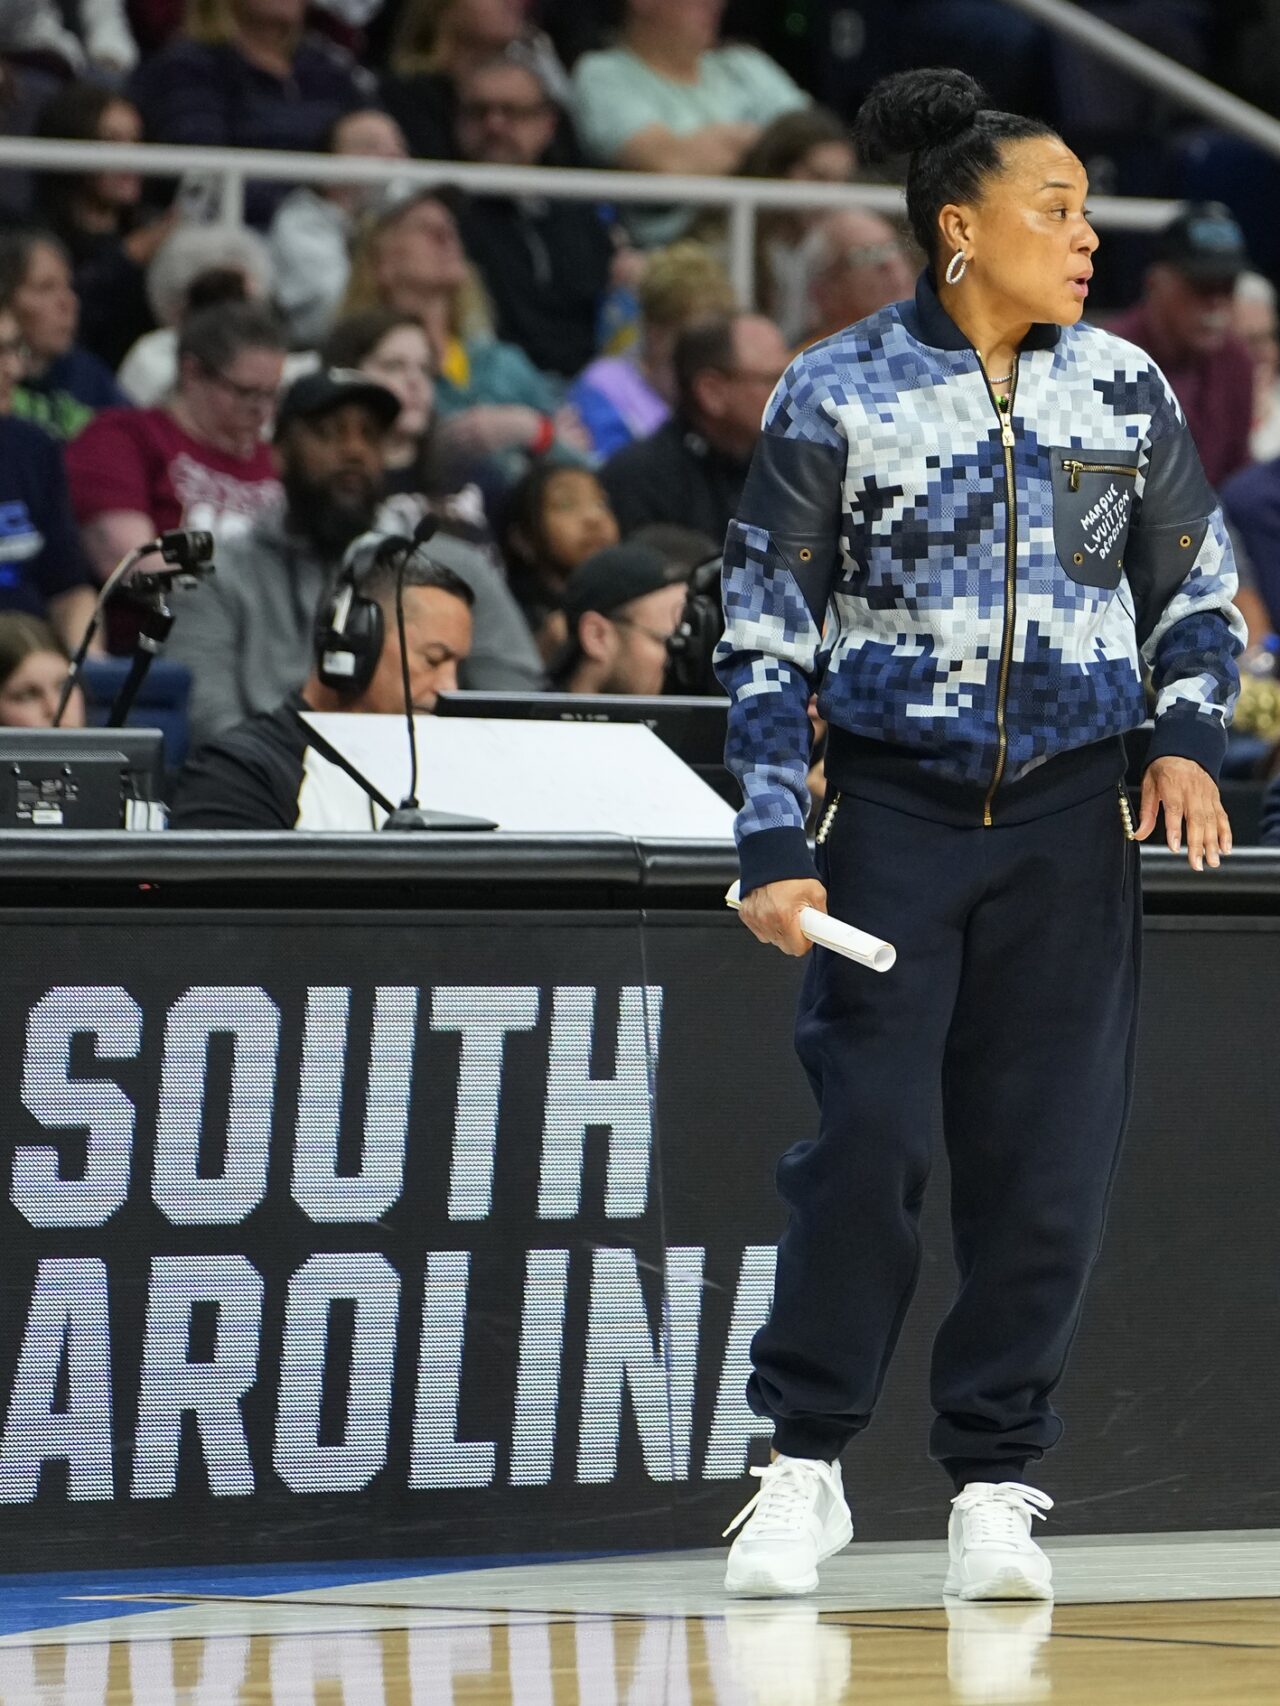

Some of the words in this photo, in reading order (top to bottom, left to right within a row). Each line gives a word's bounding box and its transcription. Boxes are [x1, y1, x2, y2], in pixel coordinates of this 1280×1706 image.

[1080, 482, 1119, 531] MARQUE
[1083, 542, 1099, 554] L.
[1091, 489, 1130, 543] VUITTON
[10, 984, 664, 1228] SOUTH
